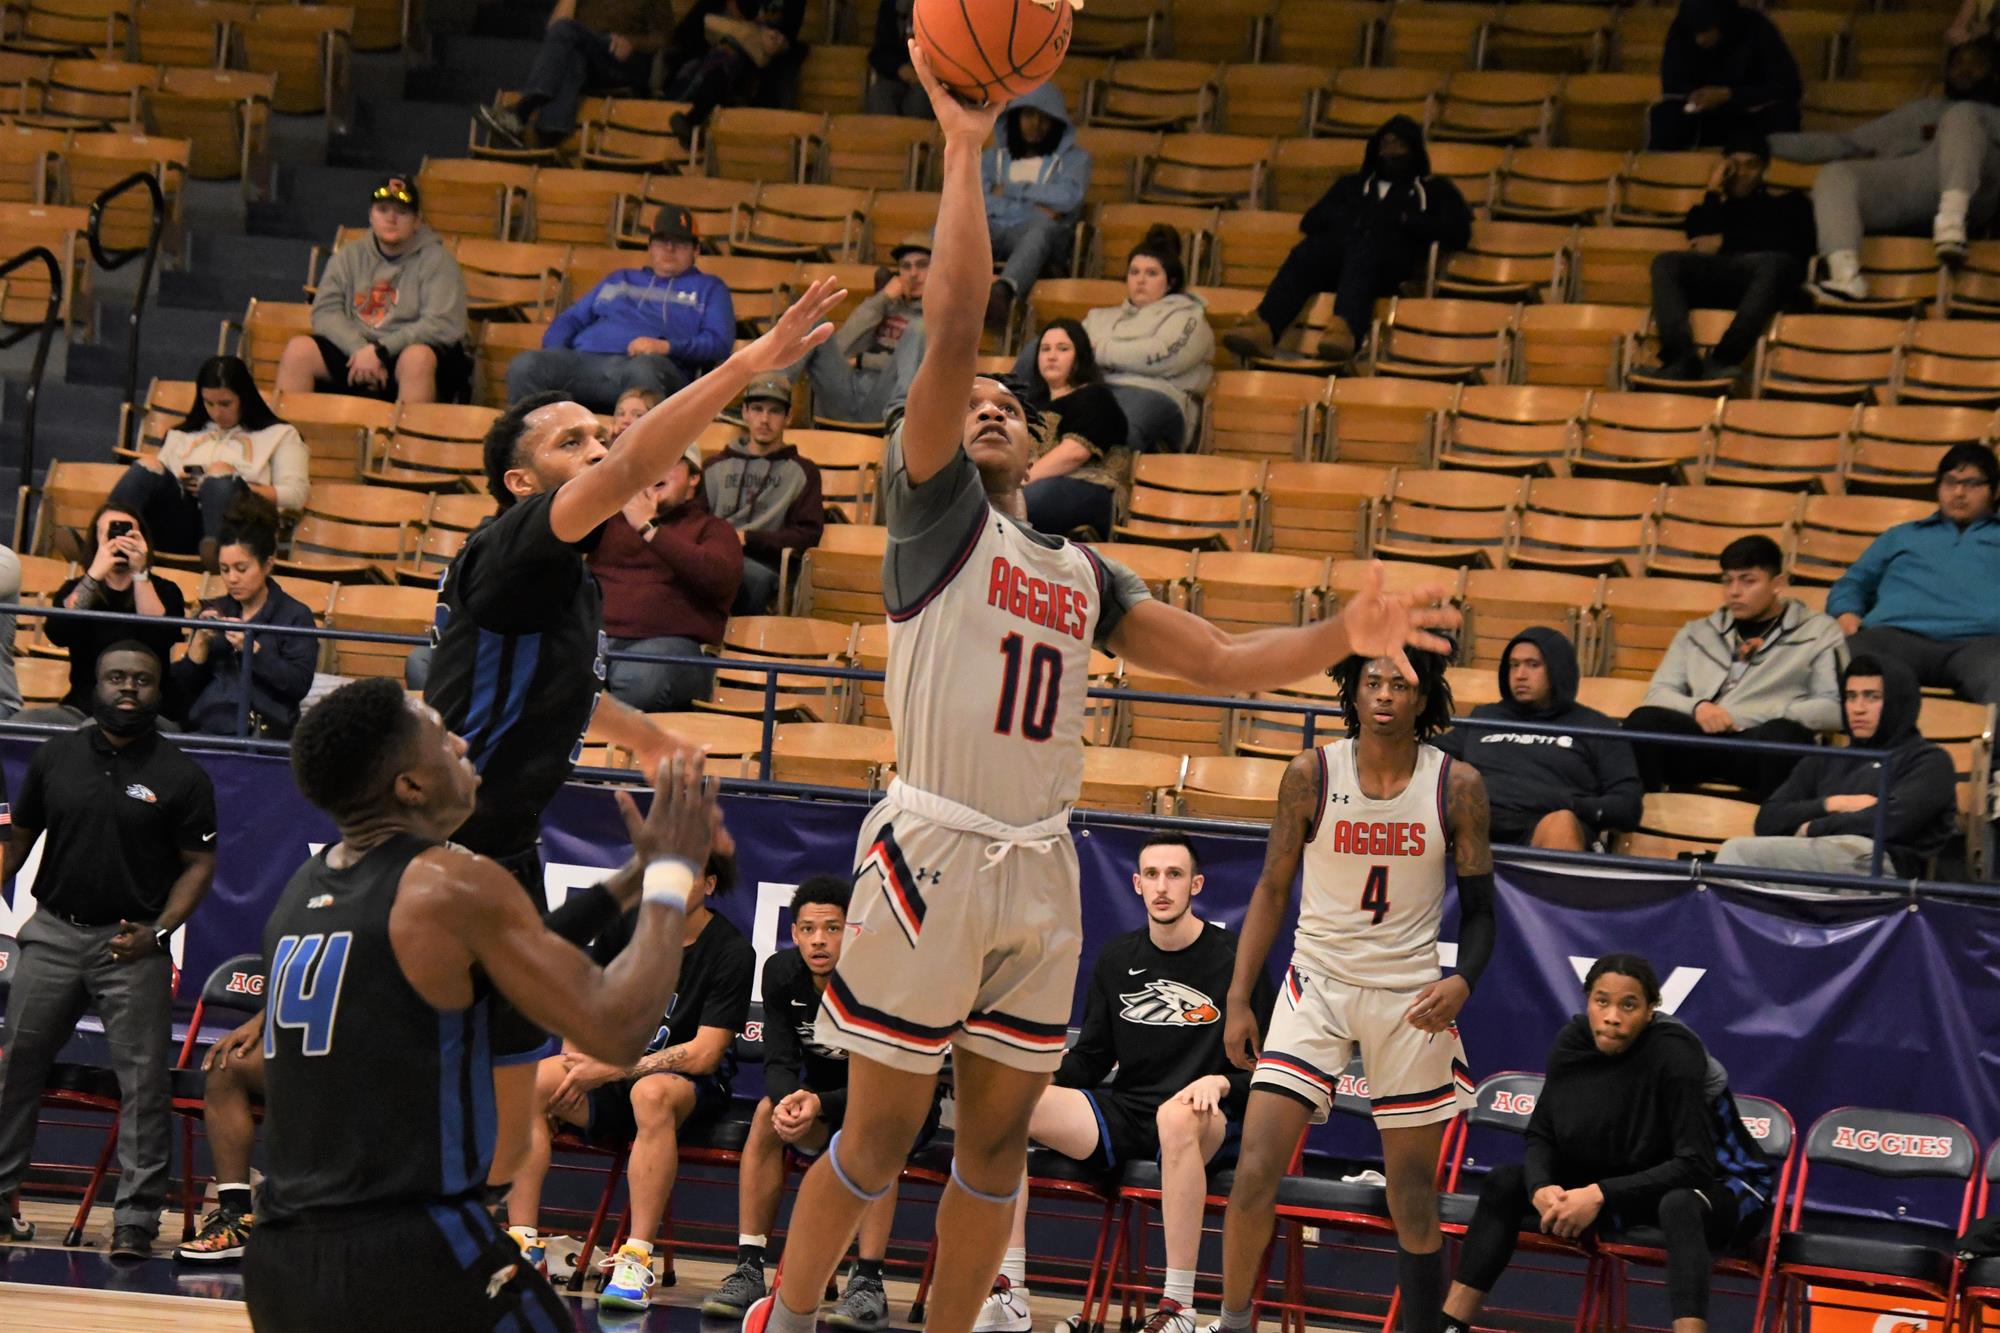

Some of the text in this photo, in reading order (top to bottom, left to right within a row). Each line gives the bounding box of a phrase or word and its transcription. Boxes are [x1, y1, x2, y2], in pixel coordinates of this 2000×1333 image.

[987, 556, 1088, 640] AGGIES
[994, 631, 1063, 742] 10
[1334, 820, 1426, 856] AGGIES
[1360, 864, 1391, 926] 4
[264, 931, 353, 1059] 14
[1832, 1127, 1953, 1158] AGGIES
